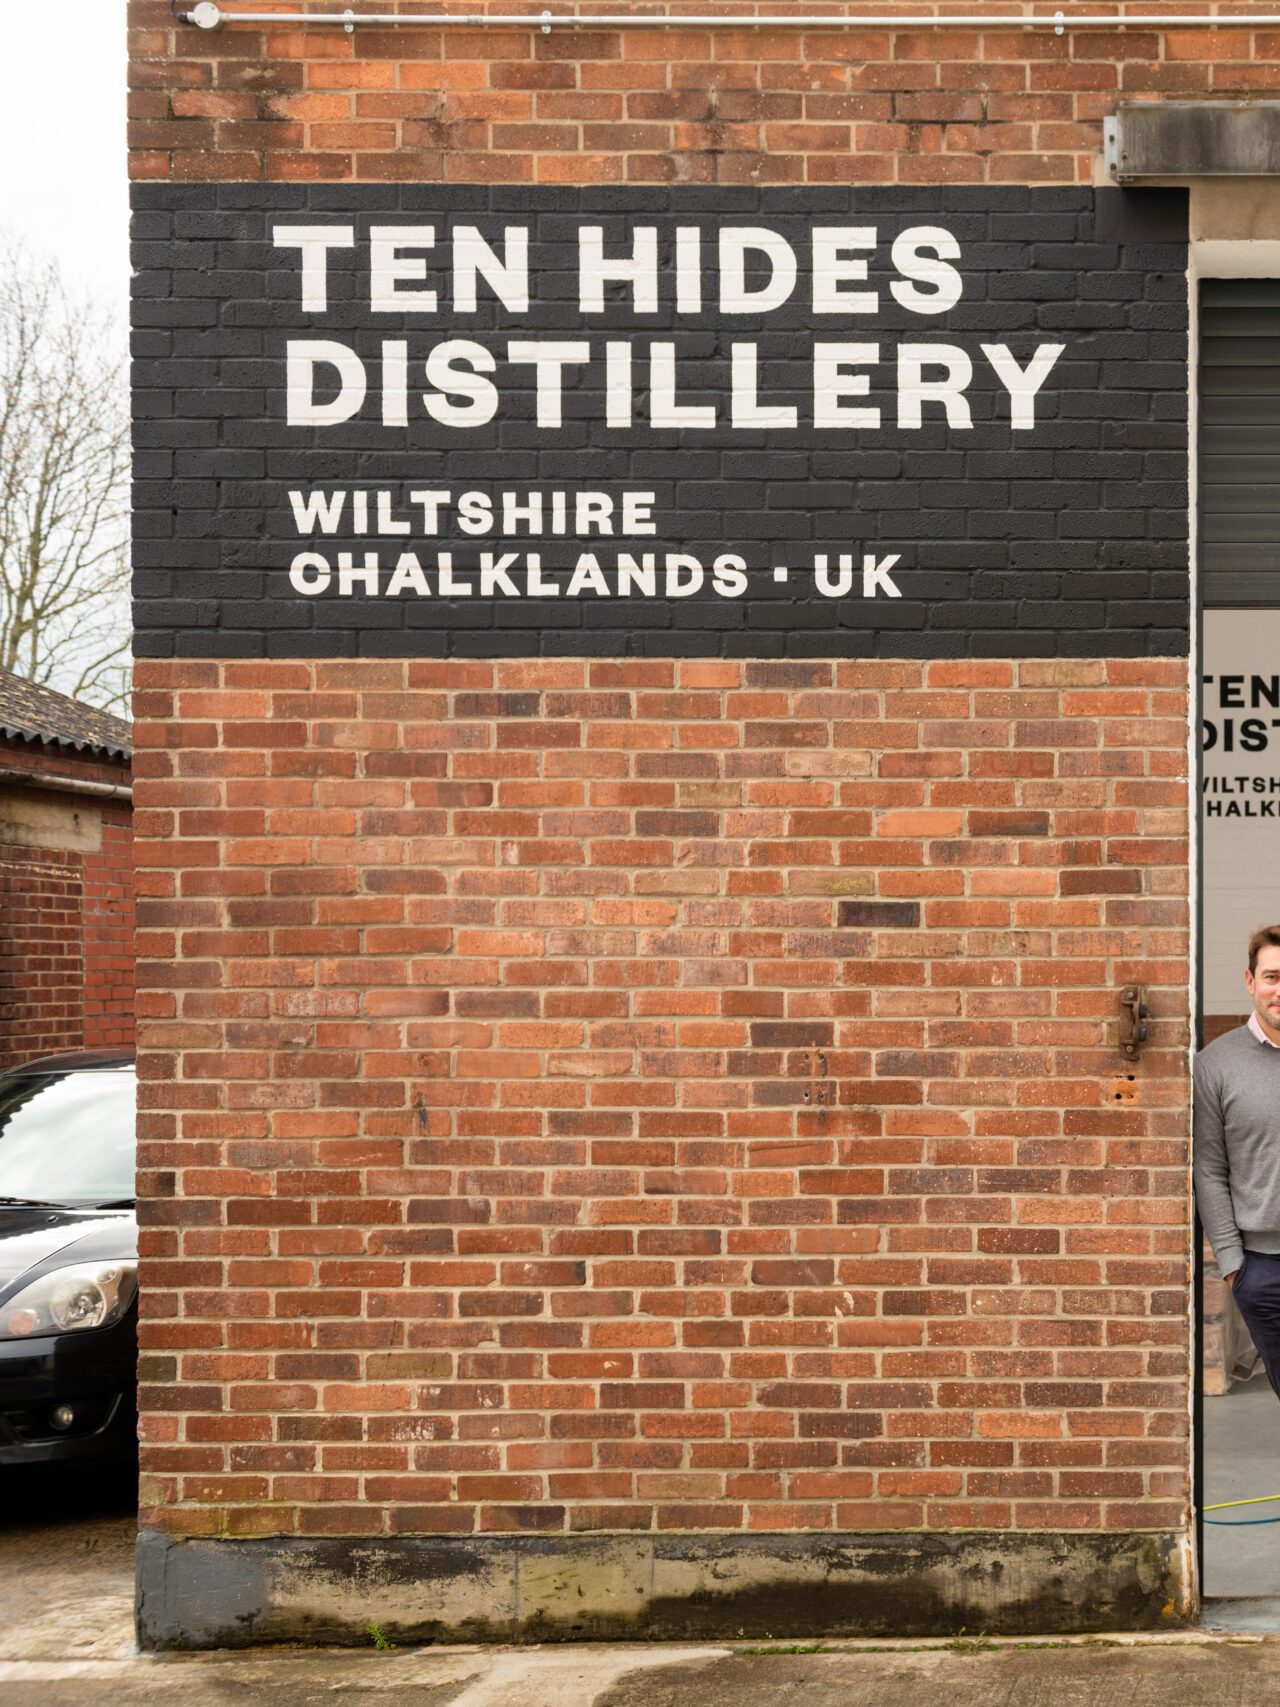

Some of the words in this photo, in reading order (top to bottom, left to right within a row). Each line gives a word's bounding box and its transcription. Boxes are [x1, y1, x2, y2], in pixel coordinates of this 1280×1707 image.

[272, 226, 530, 314] TEN
[578, 226, 963, 314] HIDES
[286, 340, 1066, 431] DISTILLERY
[288, 490, 657, 536] WILTSHIRE
[288, 552, 748, 598] CHALKLANDS
[814, 552, 903, 598] UK
